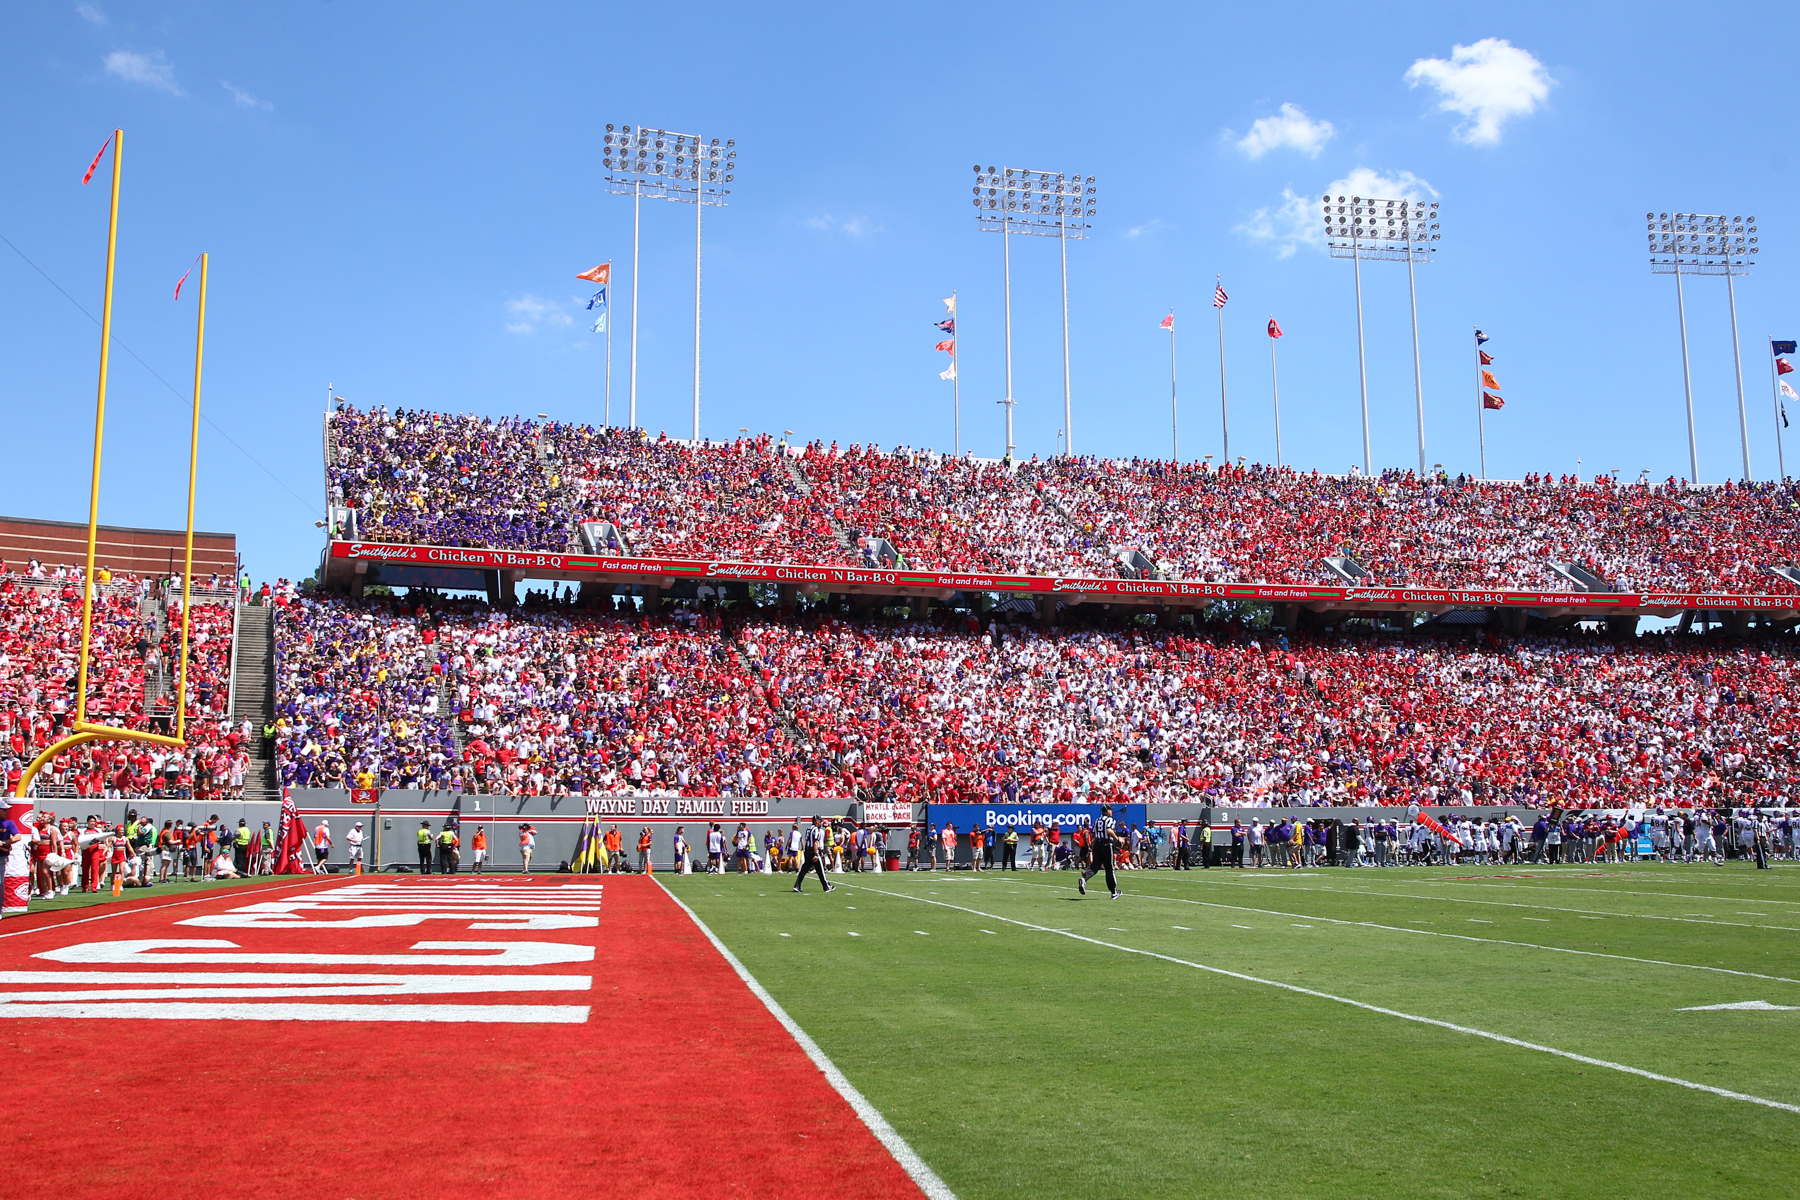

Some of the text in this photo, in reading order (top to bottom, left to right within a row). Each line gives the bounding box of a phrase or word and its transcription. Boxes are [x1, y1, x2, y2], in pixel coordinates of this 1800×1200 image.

[348, 543, 417, 560] Smithfield's
[428, 549, 485, 563] Chicken
[602, 561, 662, 572] Fast and Fresh
[706, 563, 768, 579] Smithfield's
[776, 567, 828, 580] Chicken
[938, 576, 993, 586] Fast and Fresh
[1051, 578, 1109, 593] Smithfield's
[1116, 582, 1164, 593] Chicken
[1258, 588, 1308, 598] Fast and Fresh
[1344, 588, 1396, 602] Smithfield's
[1402, 590, 1446, 601] Chicken
[1539, 595, 1588, 604] Fast and Fresh
[1639, 594, 1689, 607] Smithfield's
[1695, 596, 1738, 606] Chicken
[474, 800, 481, 812] 1
[585, 799, 770, 816] WAYNE DAY FAMILY FIELD
[865, 803, 890, 811] MYRTLE
[865, 812, 911, 821] BACKS PACK
[986, 810, 1091, 828] Bookingcom
[1221, 812, 1228, 822] 3
[1097, 820, 1104, 832] B
[1654, 819, 1665, 827] 84
[0, 884, 604, 1024] NC STATE
